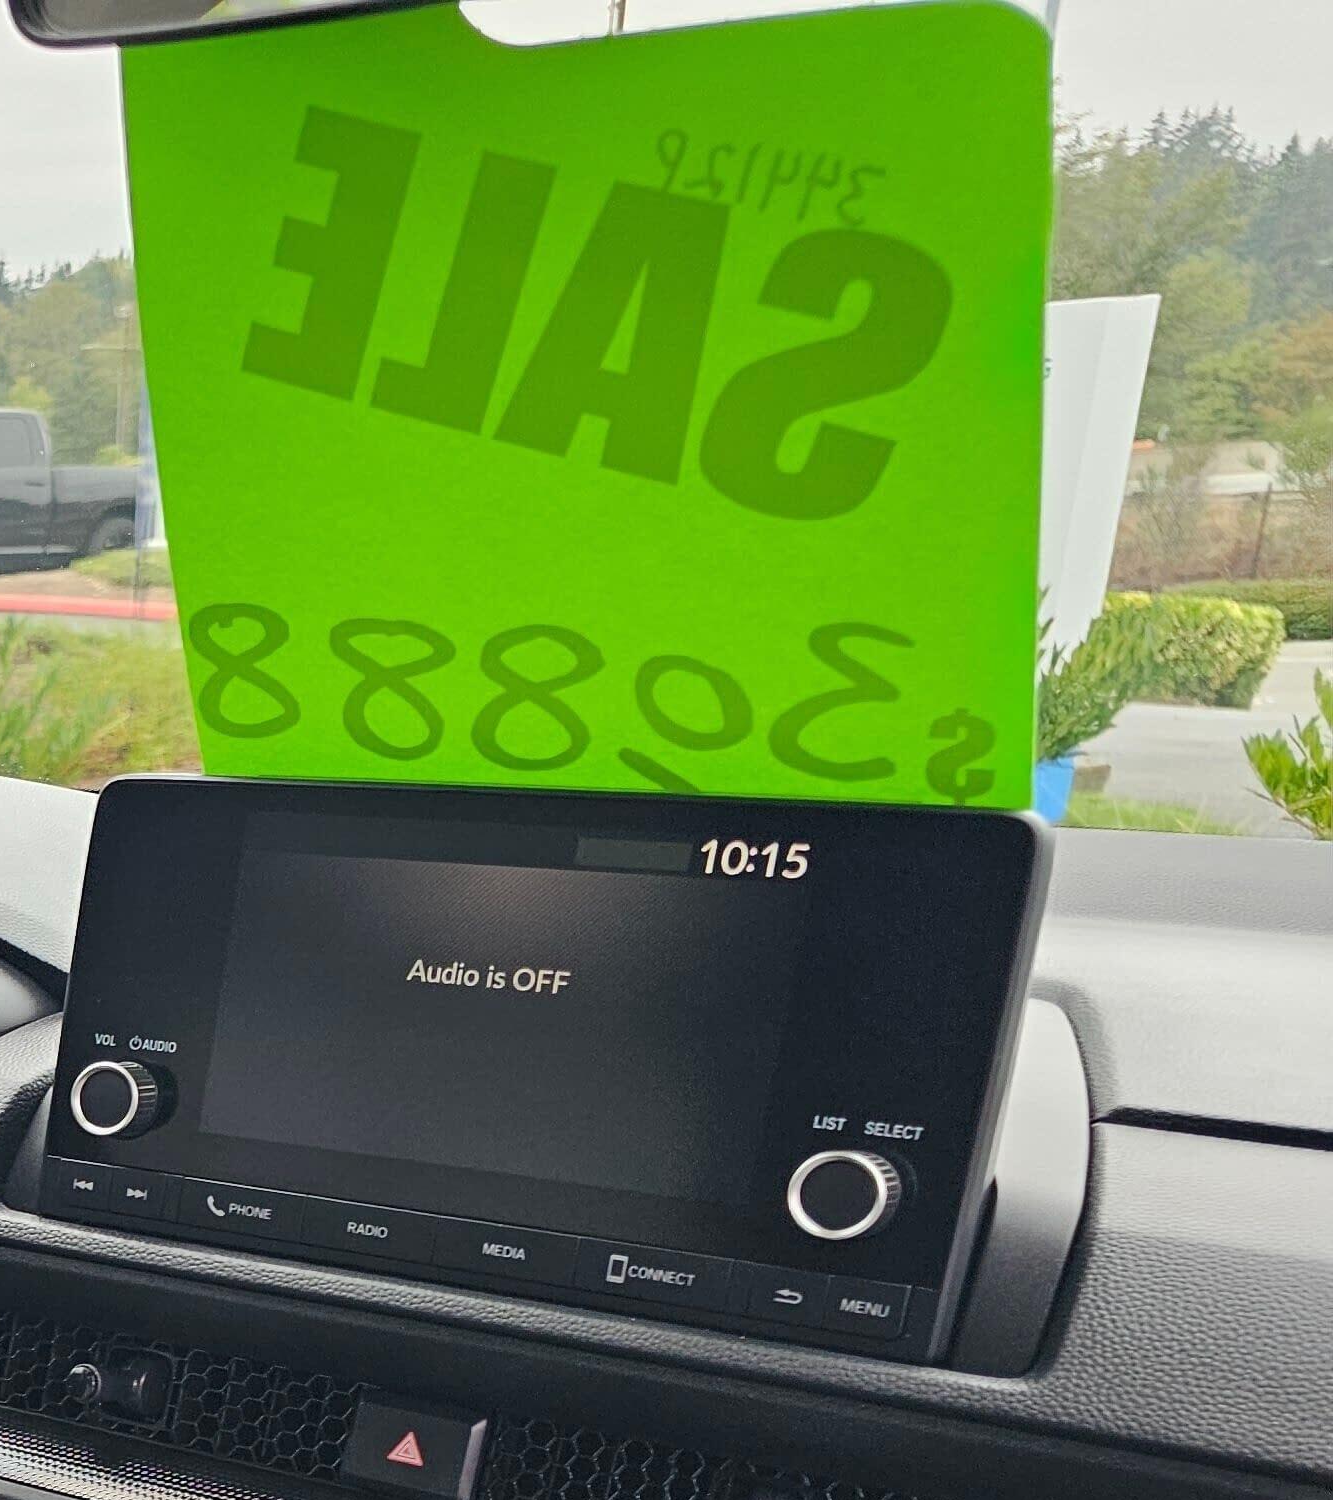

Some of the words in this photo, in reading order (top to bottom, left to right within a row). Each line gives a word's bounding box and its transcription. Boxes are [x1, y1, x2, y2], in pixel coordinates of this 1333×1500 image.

[700, 838, 811, 879] 10:15
[405, 959, 480, 988] Audio
[485, 965, 506, 990] is
[512, 967, 572, 996] OFF
[94, 1033, 117, 1047] VOL
[141, 1039, 177, 1053] AUDIO
[812, 1115, 847, 1131] LIST
[863, 1121, 925, 1140] SELECT
[228, 1203, 272, 1220] PHONE
[346, 1221, 389, 1239] RADIO
[482, 1241, 526, 1261] MEDIA
[627, 1264, 696, 1287] CONNECT
[838, 1297, 891, 1319] MENU
